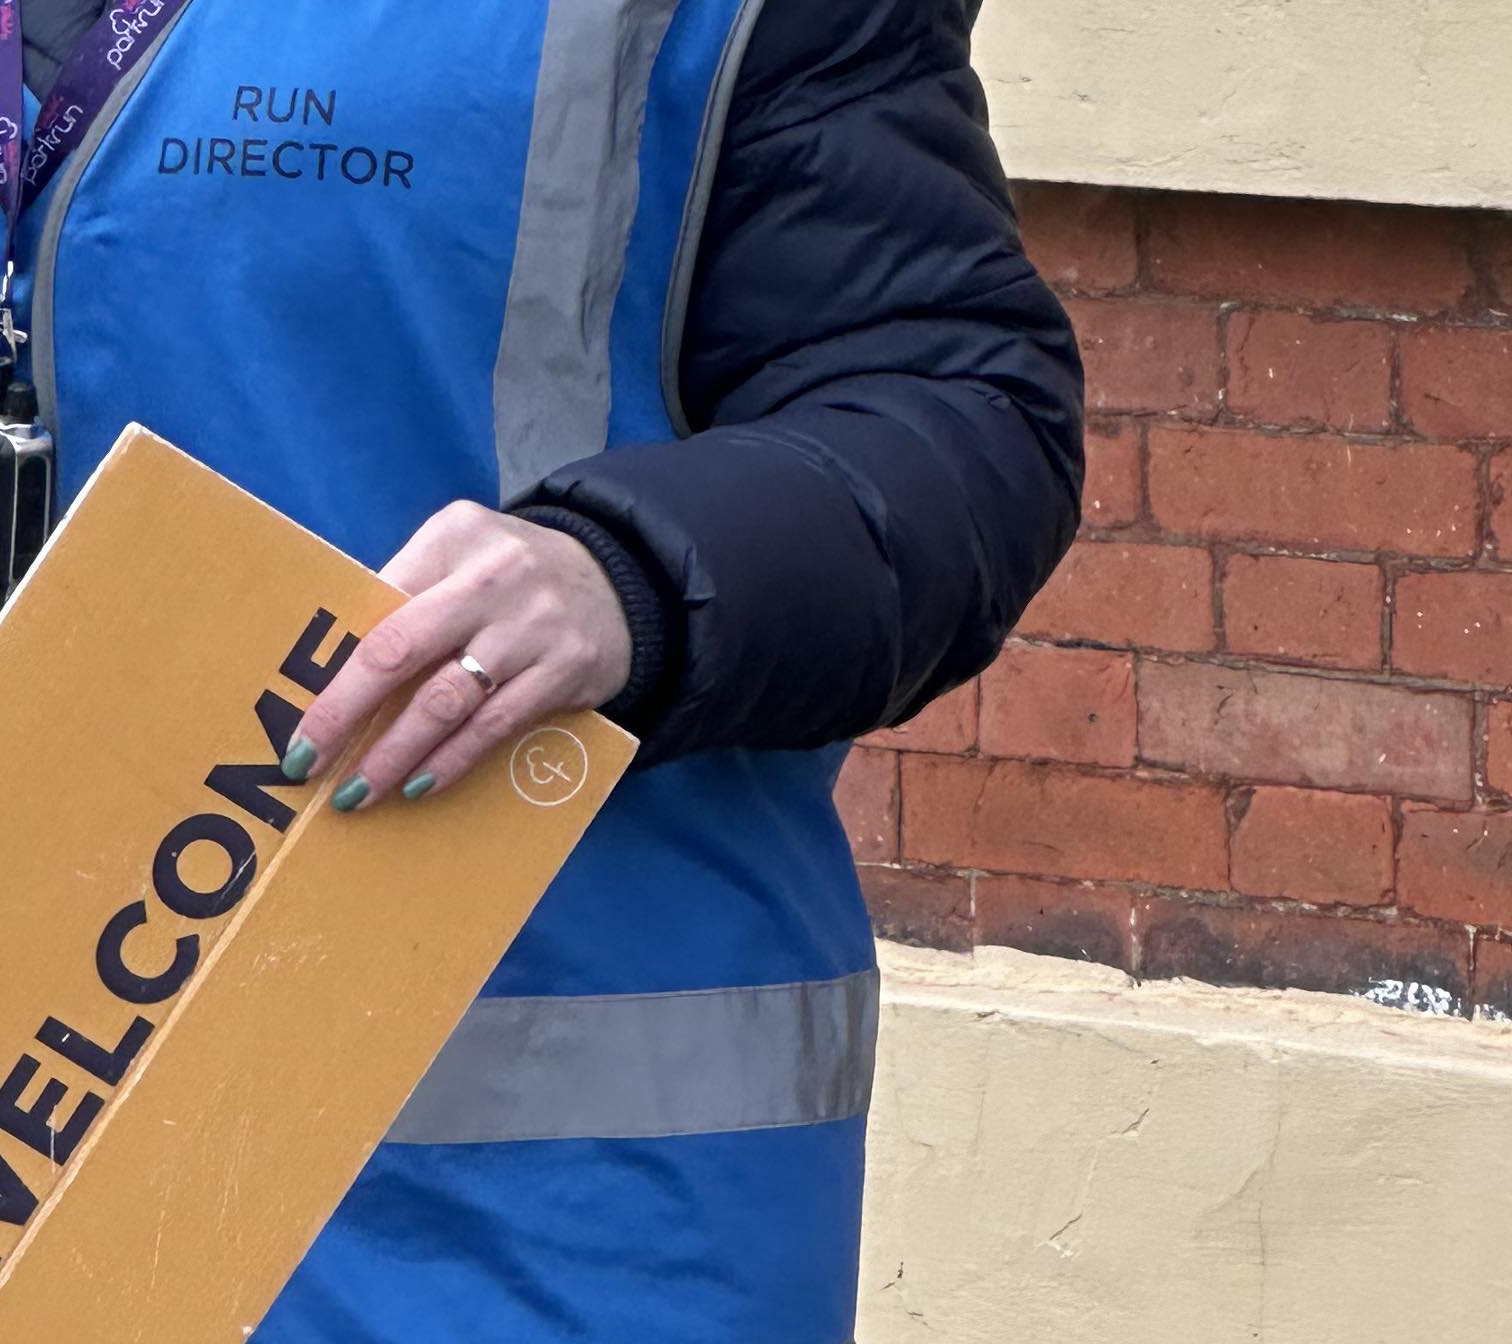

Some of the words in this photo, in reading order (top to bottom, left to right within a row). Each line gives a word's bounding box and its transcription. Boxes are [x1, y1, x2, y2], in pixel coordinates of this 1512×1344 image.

[232, 85, 337, 126] RUN
[21, 105, 84, 186] parkrun
[157, 137, 415, 190] DIRECTOR
